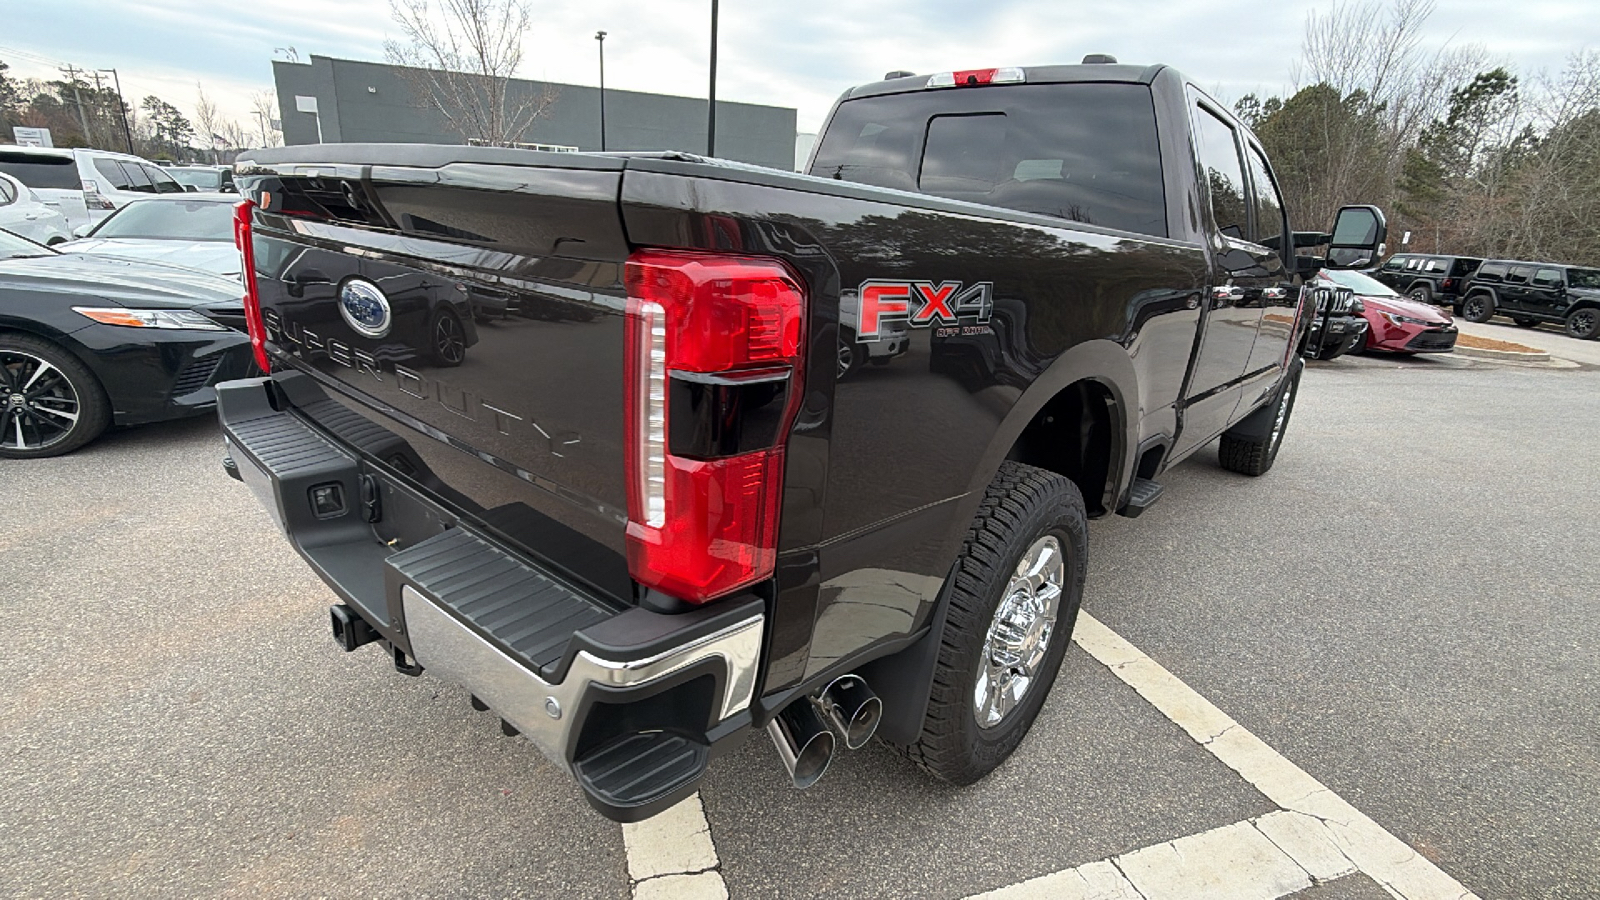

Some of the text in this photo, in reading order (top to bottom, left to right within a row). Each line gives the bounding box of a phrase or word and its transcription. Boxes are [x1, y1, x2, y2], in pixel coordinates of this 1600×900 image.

[856, 278, 993, 343] FX4
[265, 310, 582, 458] SUPER DUTY
